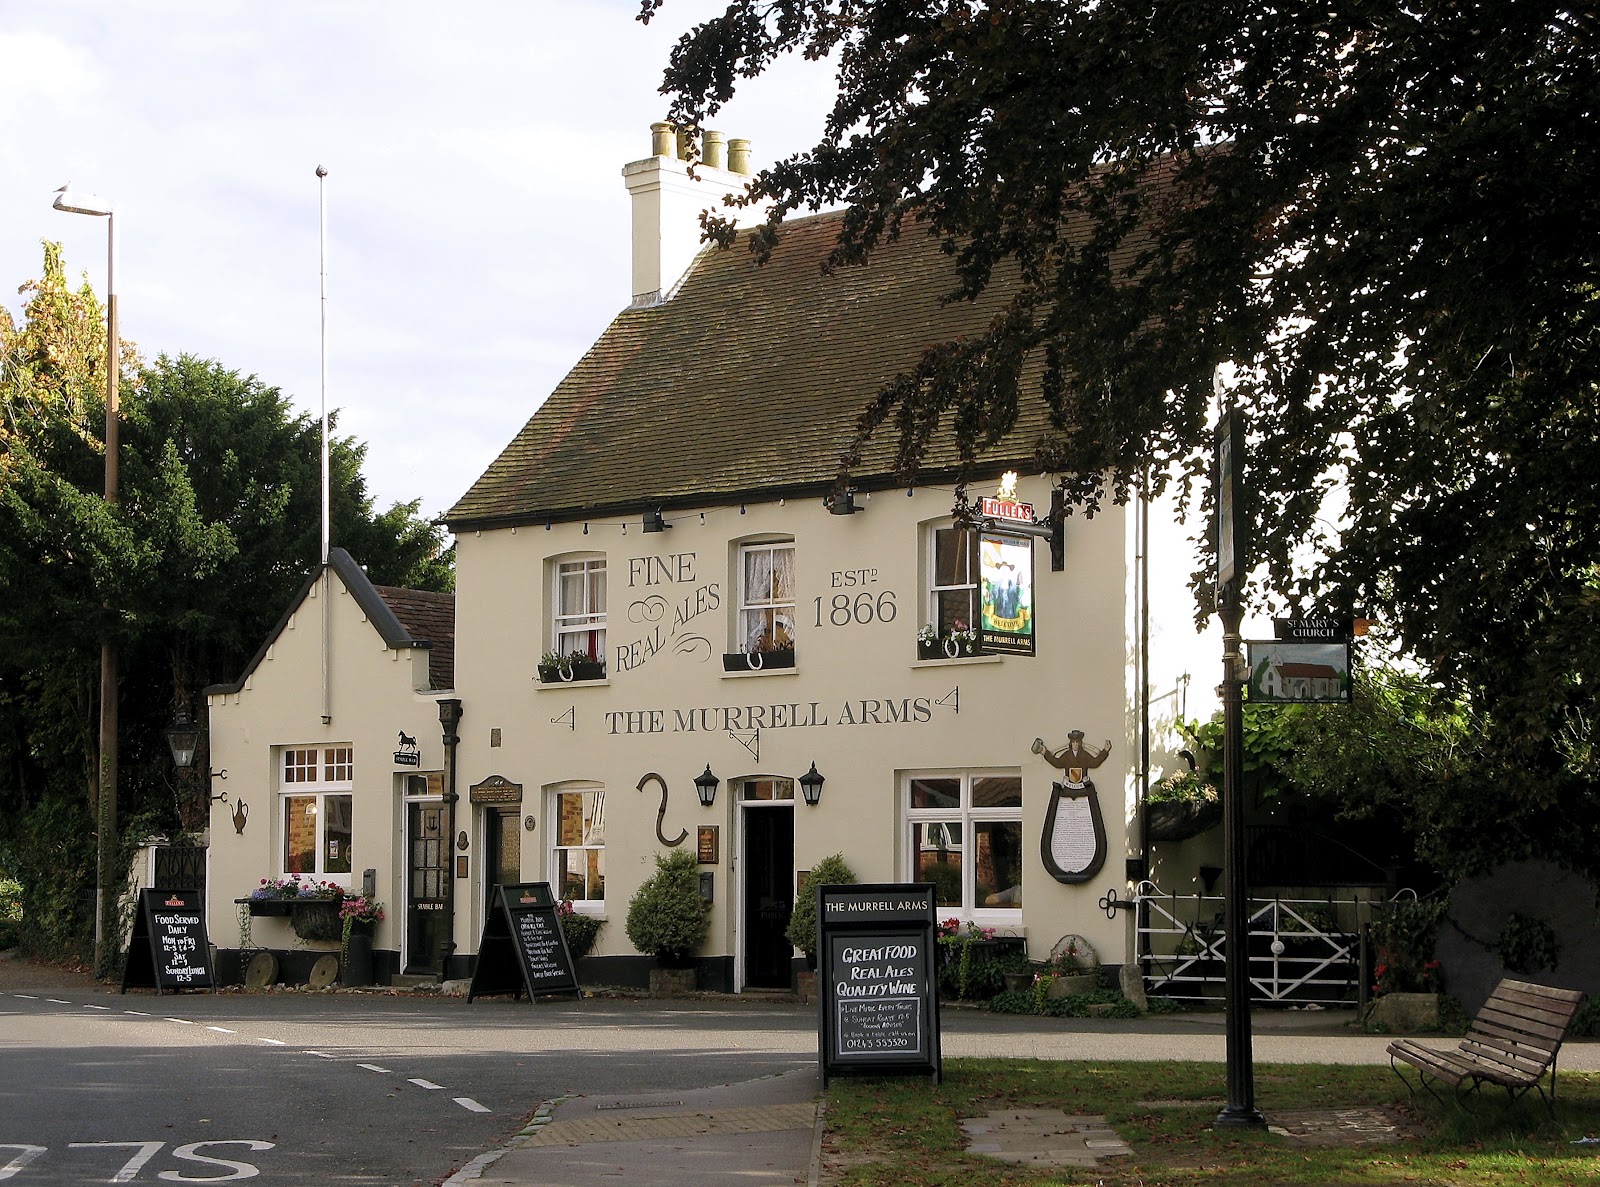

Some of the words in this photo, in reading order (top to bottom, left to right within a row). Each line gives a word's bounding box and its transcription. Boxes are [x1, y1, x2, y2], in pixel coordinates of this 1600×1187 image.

[985, 501, 1031, 520] FULLER'S
[628, 552, 696, 587] FINE
[813, 590, 897, 627] 1866
[616, 625, 666, 673] REAL
[670, 583, 720, 637] ALES
[1299, 618, 1339, 628] MARY'S
[1292, 628, 1334, 637] CHURCH
[983, 634, 993, 643] THE
[993, 636, 1016, 645] MURRELL
[1016, 638, 1031, 647] ARMS
[604, 710, 664, 735] THE
[672, 702, 829, 733] MURRELL
[836, 697, 932, 726] ARMS
[825, 902, 845, 912] THE
[847, 901, 895, 912] MURRELL
[896, 900, 928, 911] ARMS
[154, 914, 174, 924] FOOD
[174, 913, 199, 924] SERVED
[167, 925, 187, 934] DAILY
[162, 935, 176, 945] MON
[183, 936, 196, 946] FRI
[173, 952, 187, 961] SAT
[842, 947, 885, 964] GREAT
[884, 945, 917, 960] FOOD
[165, 965, 189, 975] SUNDAY
[188, 966, 205, 975] LUNCH
[850, 966, 884, 981] REAL
[884, 965, 914, 978] ALES
[836, 981, 888, 997] QUALITY
[889, 980, 917, 995] WINE
[845, 1004, 858, 1013] LIVE
[858, 1003, 876, 1012] MUSIC
[878, 1003, 895, 1011] EVERY
[851, 1015, 876, 1023] SUNDAY
[876, 1013, 896, 1021] ROAST
[846, 1039, 873, 1049] 01243
